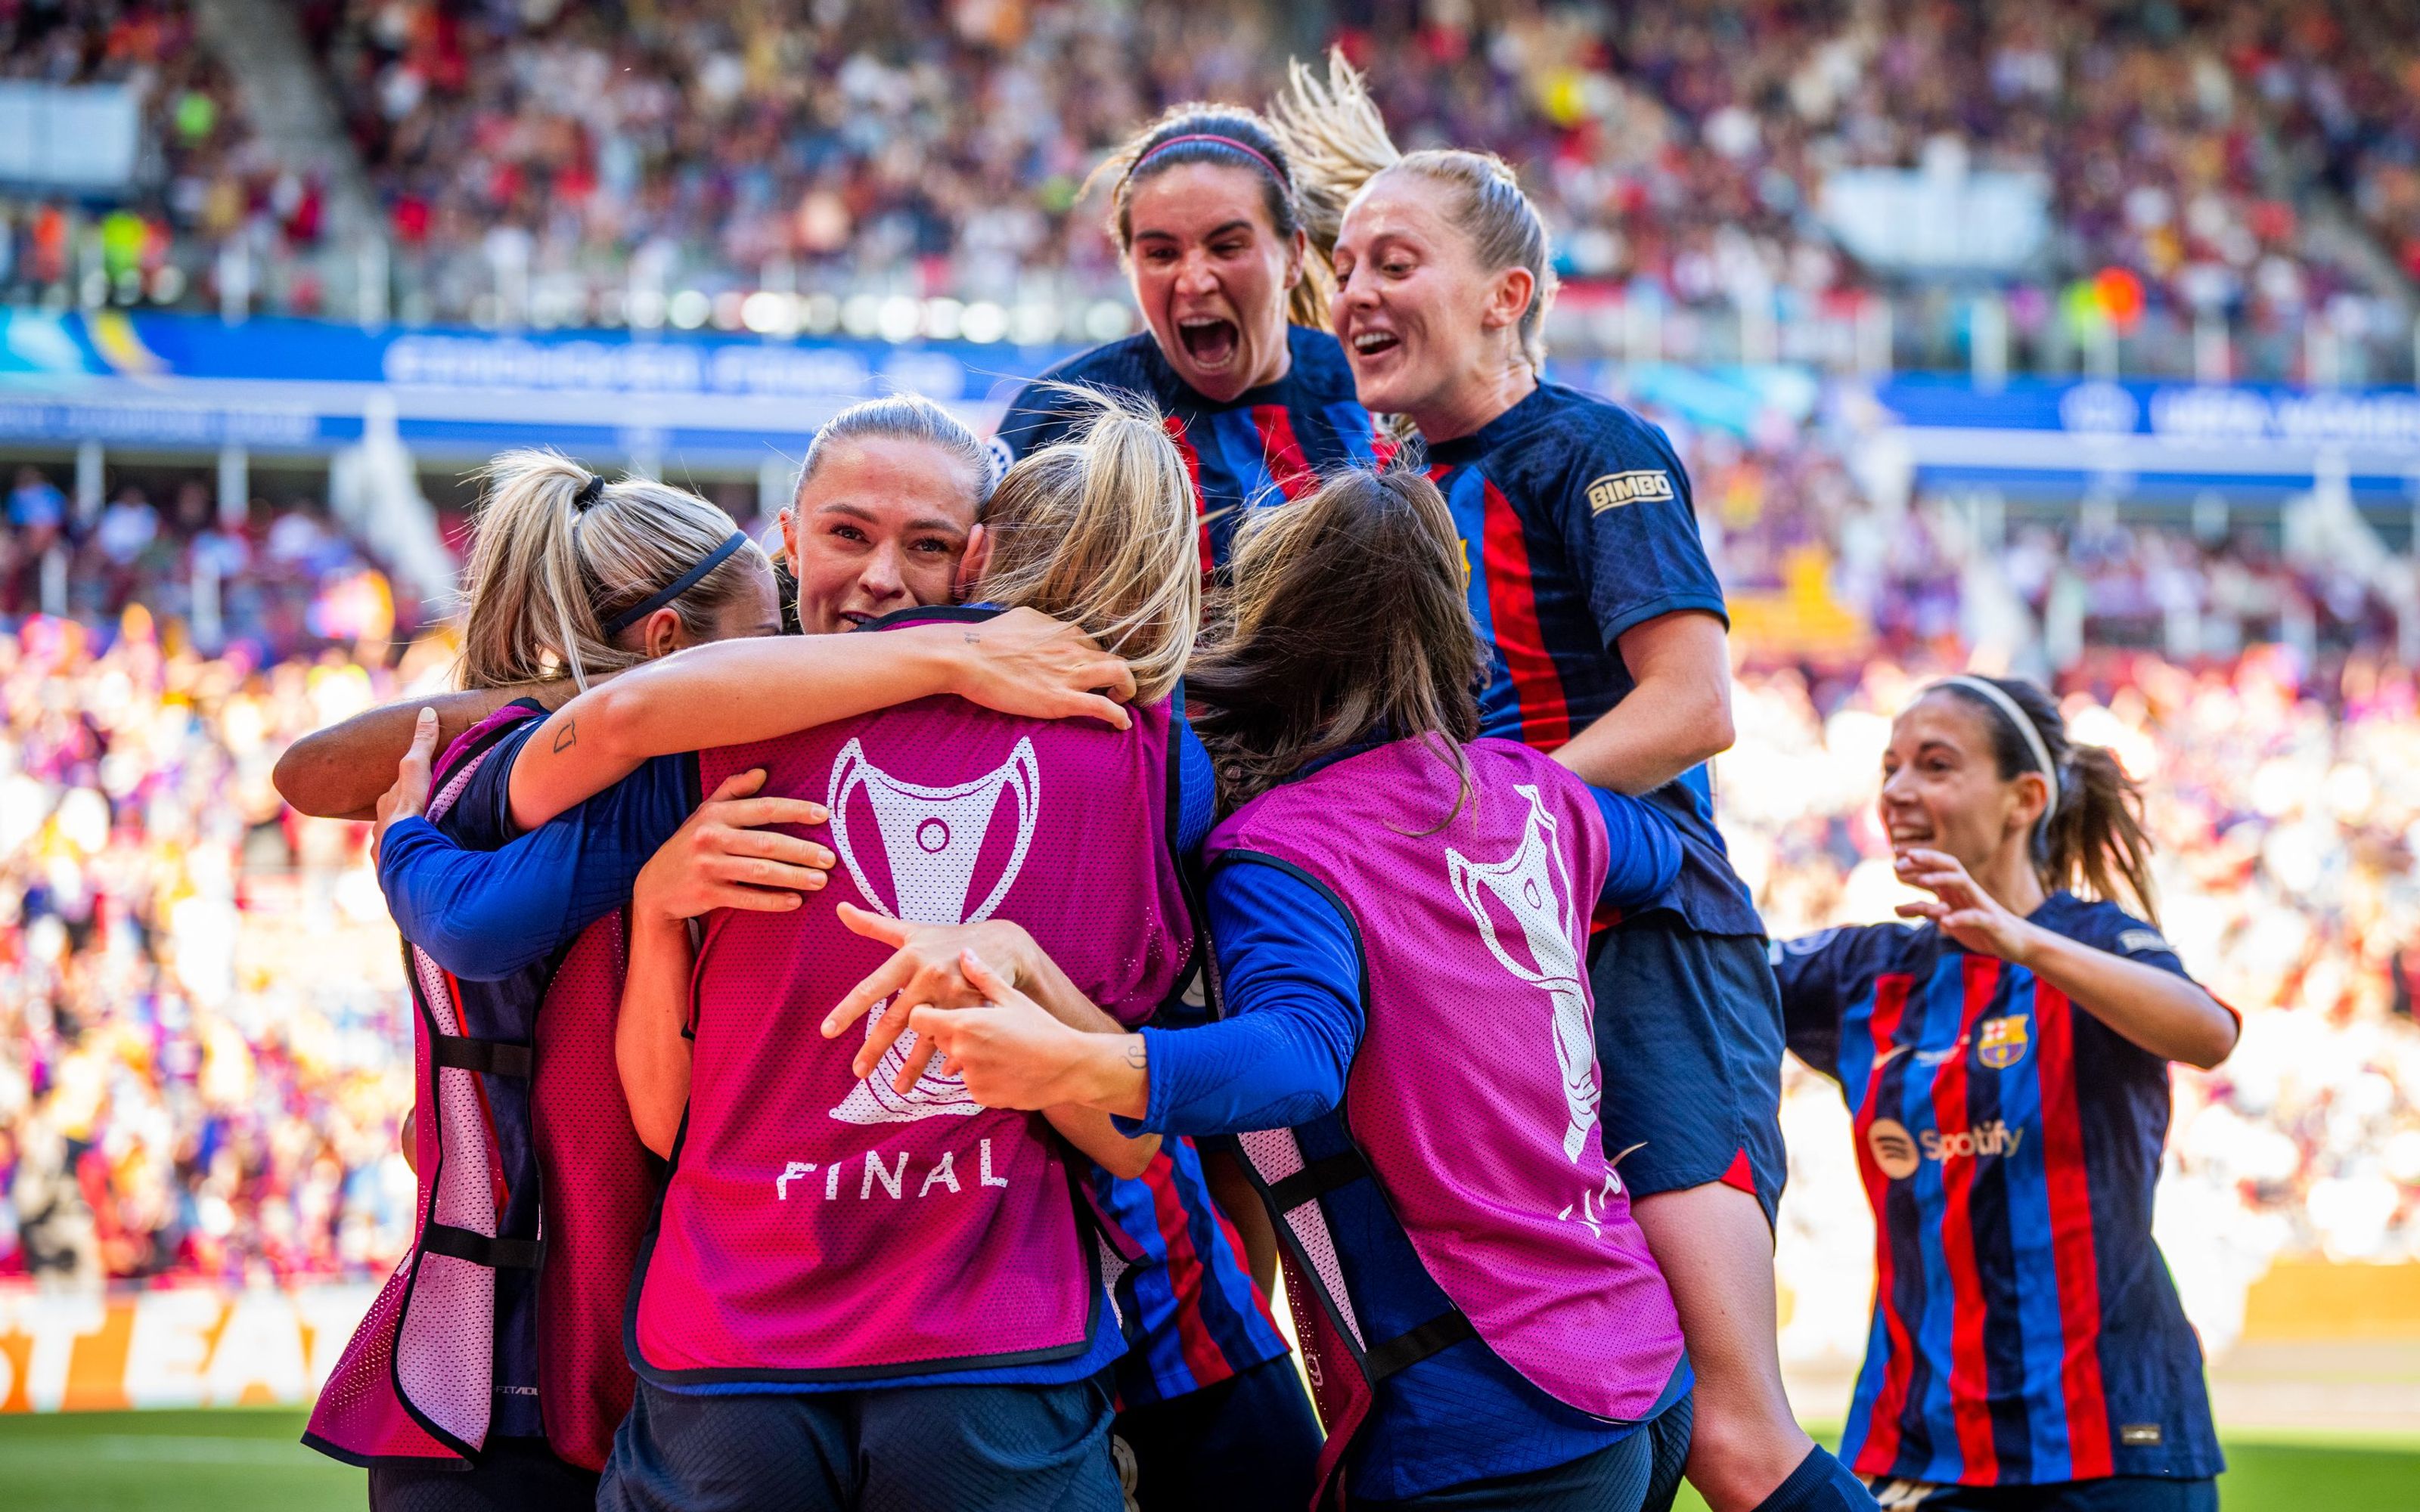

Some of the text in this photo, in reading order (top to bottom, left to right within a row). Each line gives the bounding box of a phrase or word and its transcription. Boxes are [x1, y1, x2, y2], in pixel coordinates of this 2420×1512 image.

[1589, 475, 1673, 510] BIMBO
[1919, 1120, 2024, 1165] Spotify
[776, 1138, 1009, 1201] FINAL
